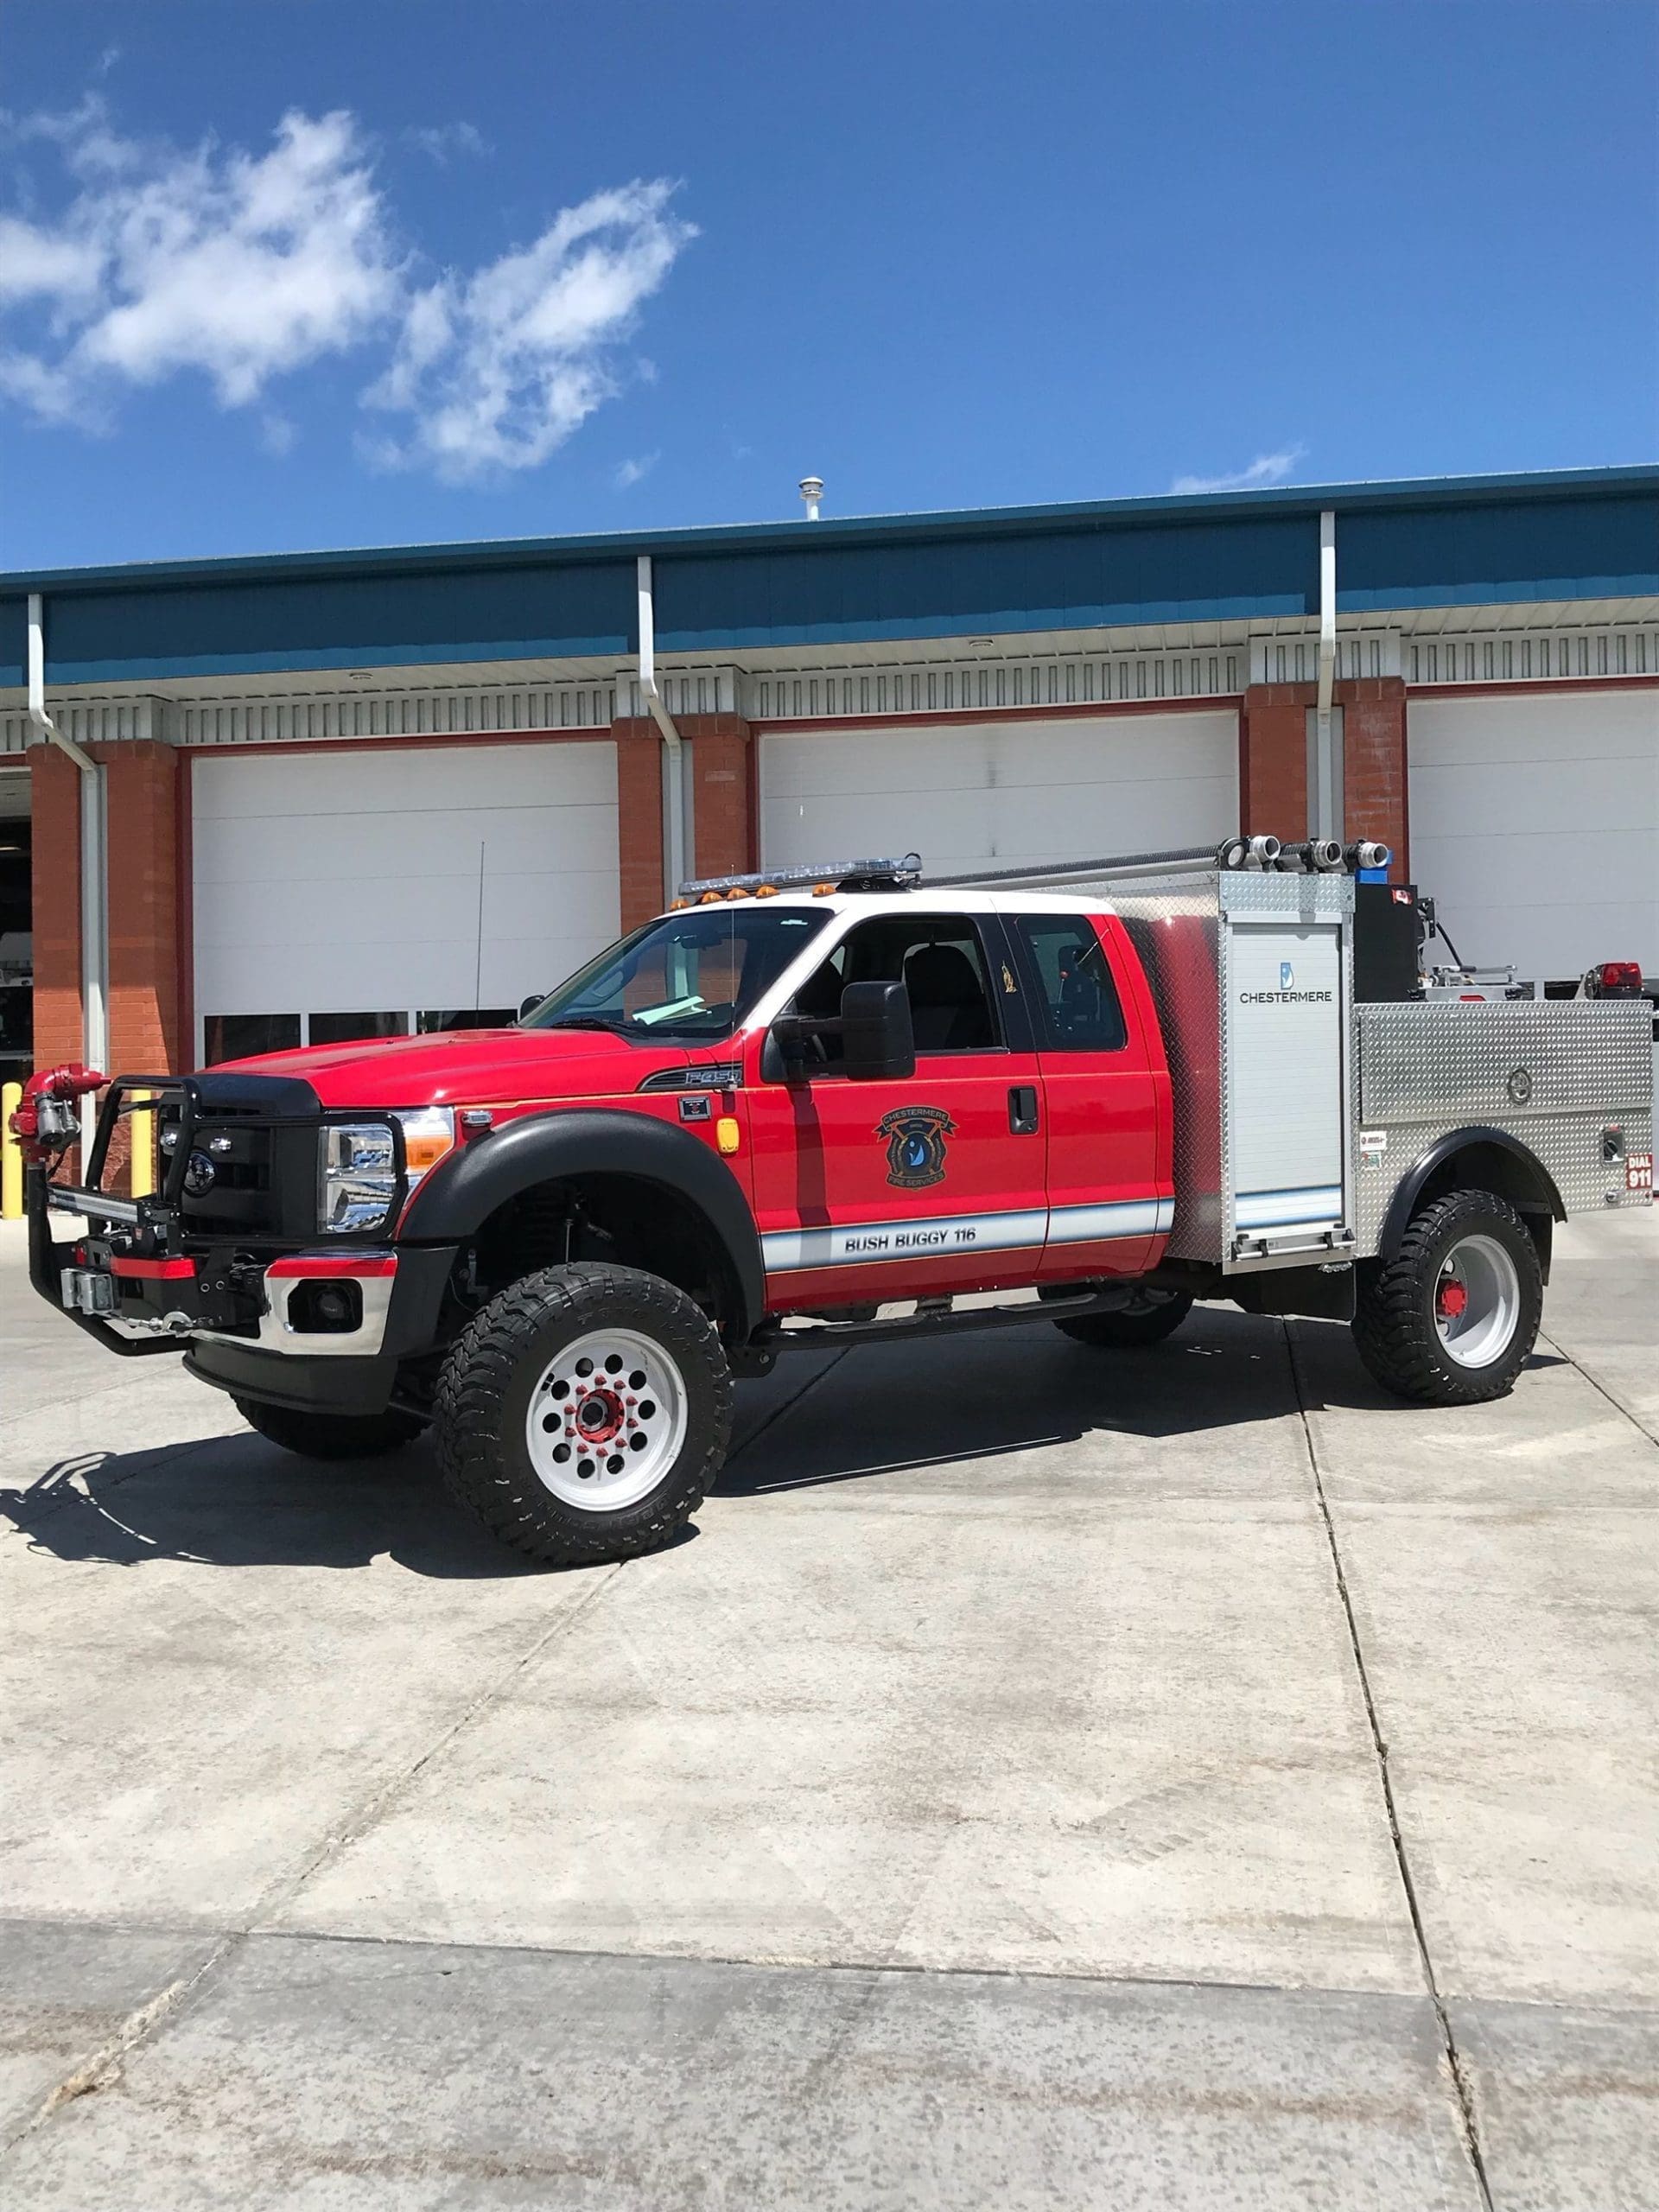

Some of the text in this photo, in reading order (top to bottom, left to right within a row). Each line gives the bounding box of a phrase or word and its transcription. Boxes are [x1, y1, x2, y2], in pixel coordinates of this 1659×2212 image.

[1240, 991, 1332, 1004] CHESTERMERE
[883, 1109, 949, 1124] CHESTERMERE
[1628, 1155, 1651, 1169] DIAL
[1629, 1169, 1651, 1188] 911
[845, 1227, 976, 1253] BUSH BUGGY 116
